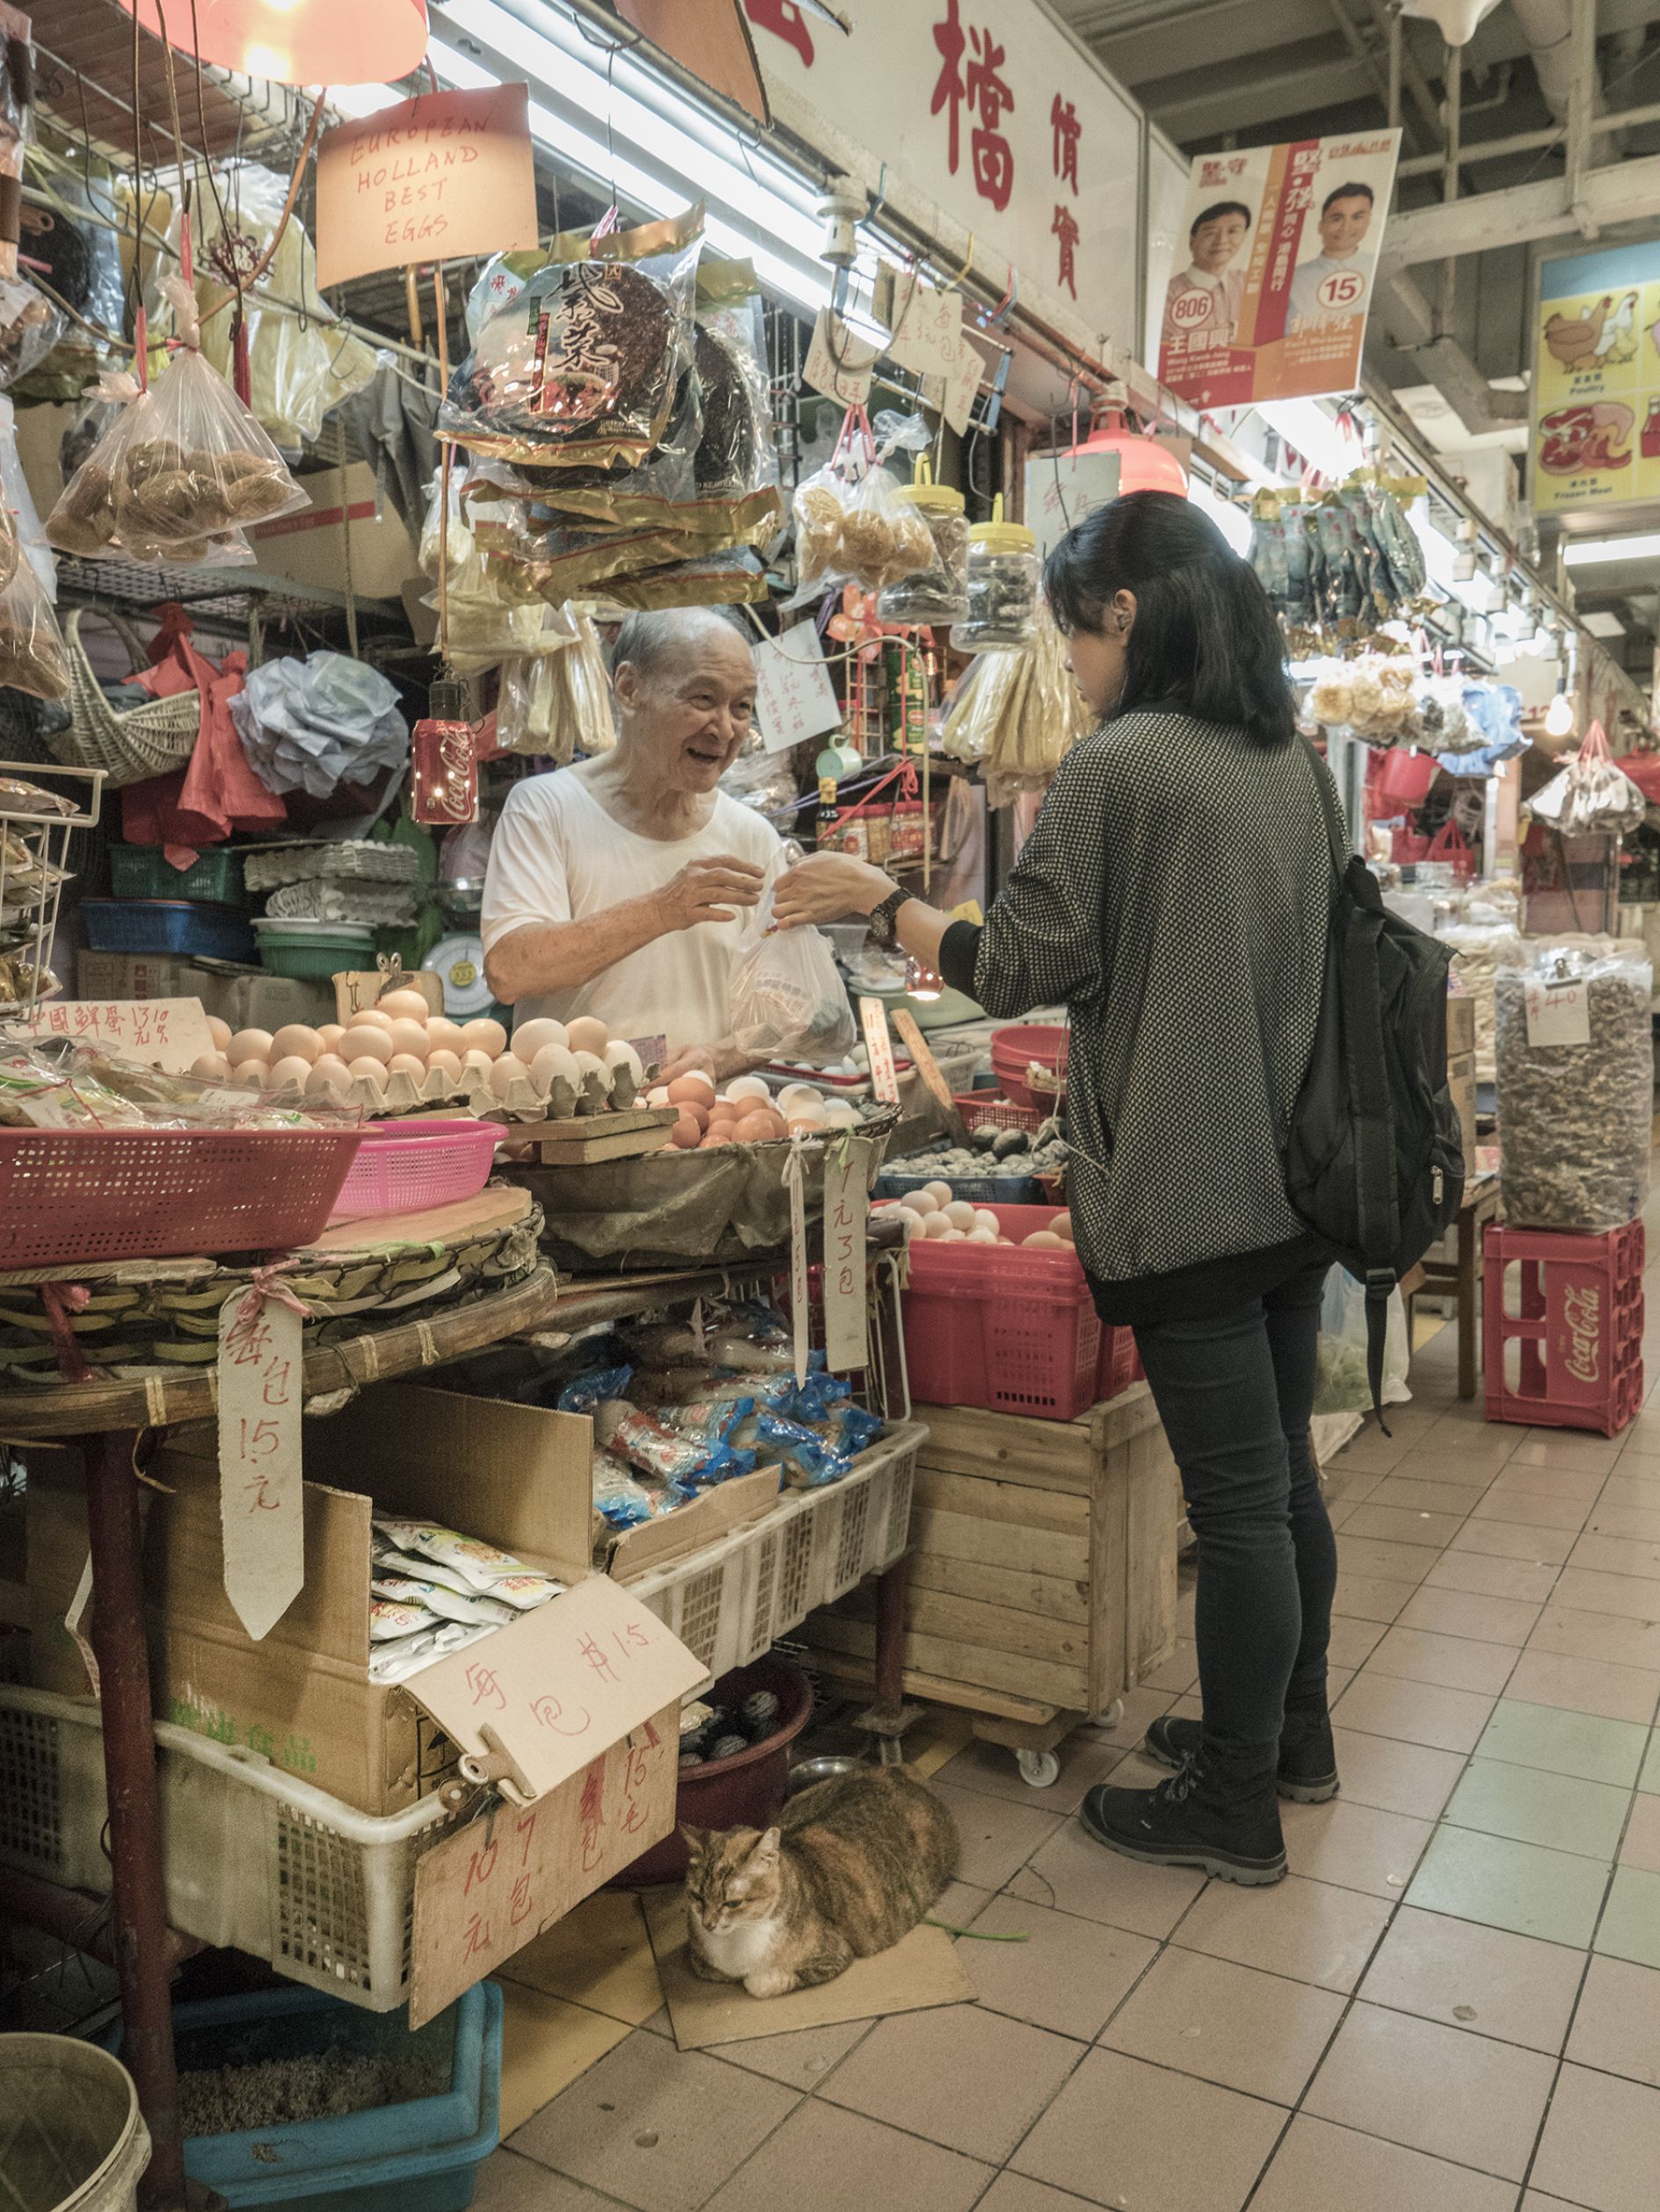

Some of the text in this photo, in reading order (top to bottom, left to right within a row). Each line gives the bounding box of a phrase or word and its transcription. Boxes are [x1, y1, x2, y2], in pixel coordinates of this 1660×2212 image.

[350, 115, 490, 166] EUROPEAN
[357, 144, 479, 193] HOLLAND
[384, 177, 448, 213] BEST
[384, 214, 449, 244] EGGS
[1324, 276, 1358, 302] 15
[1176, 295, 1209, 320] 806
